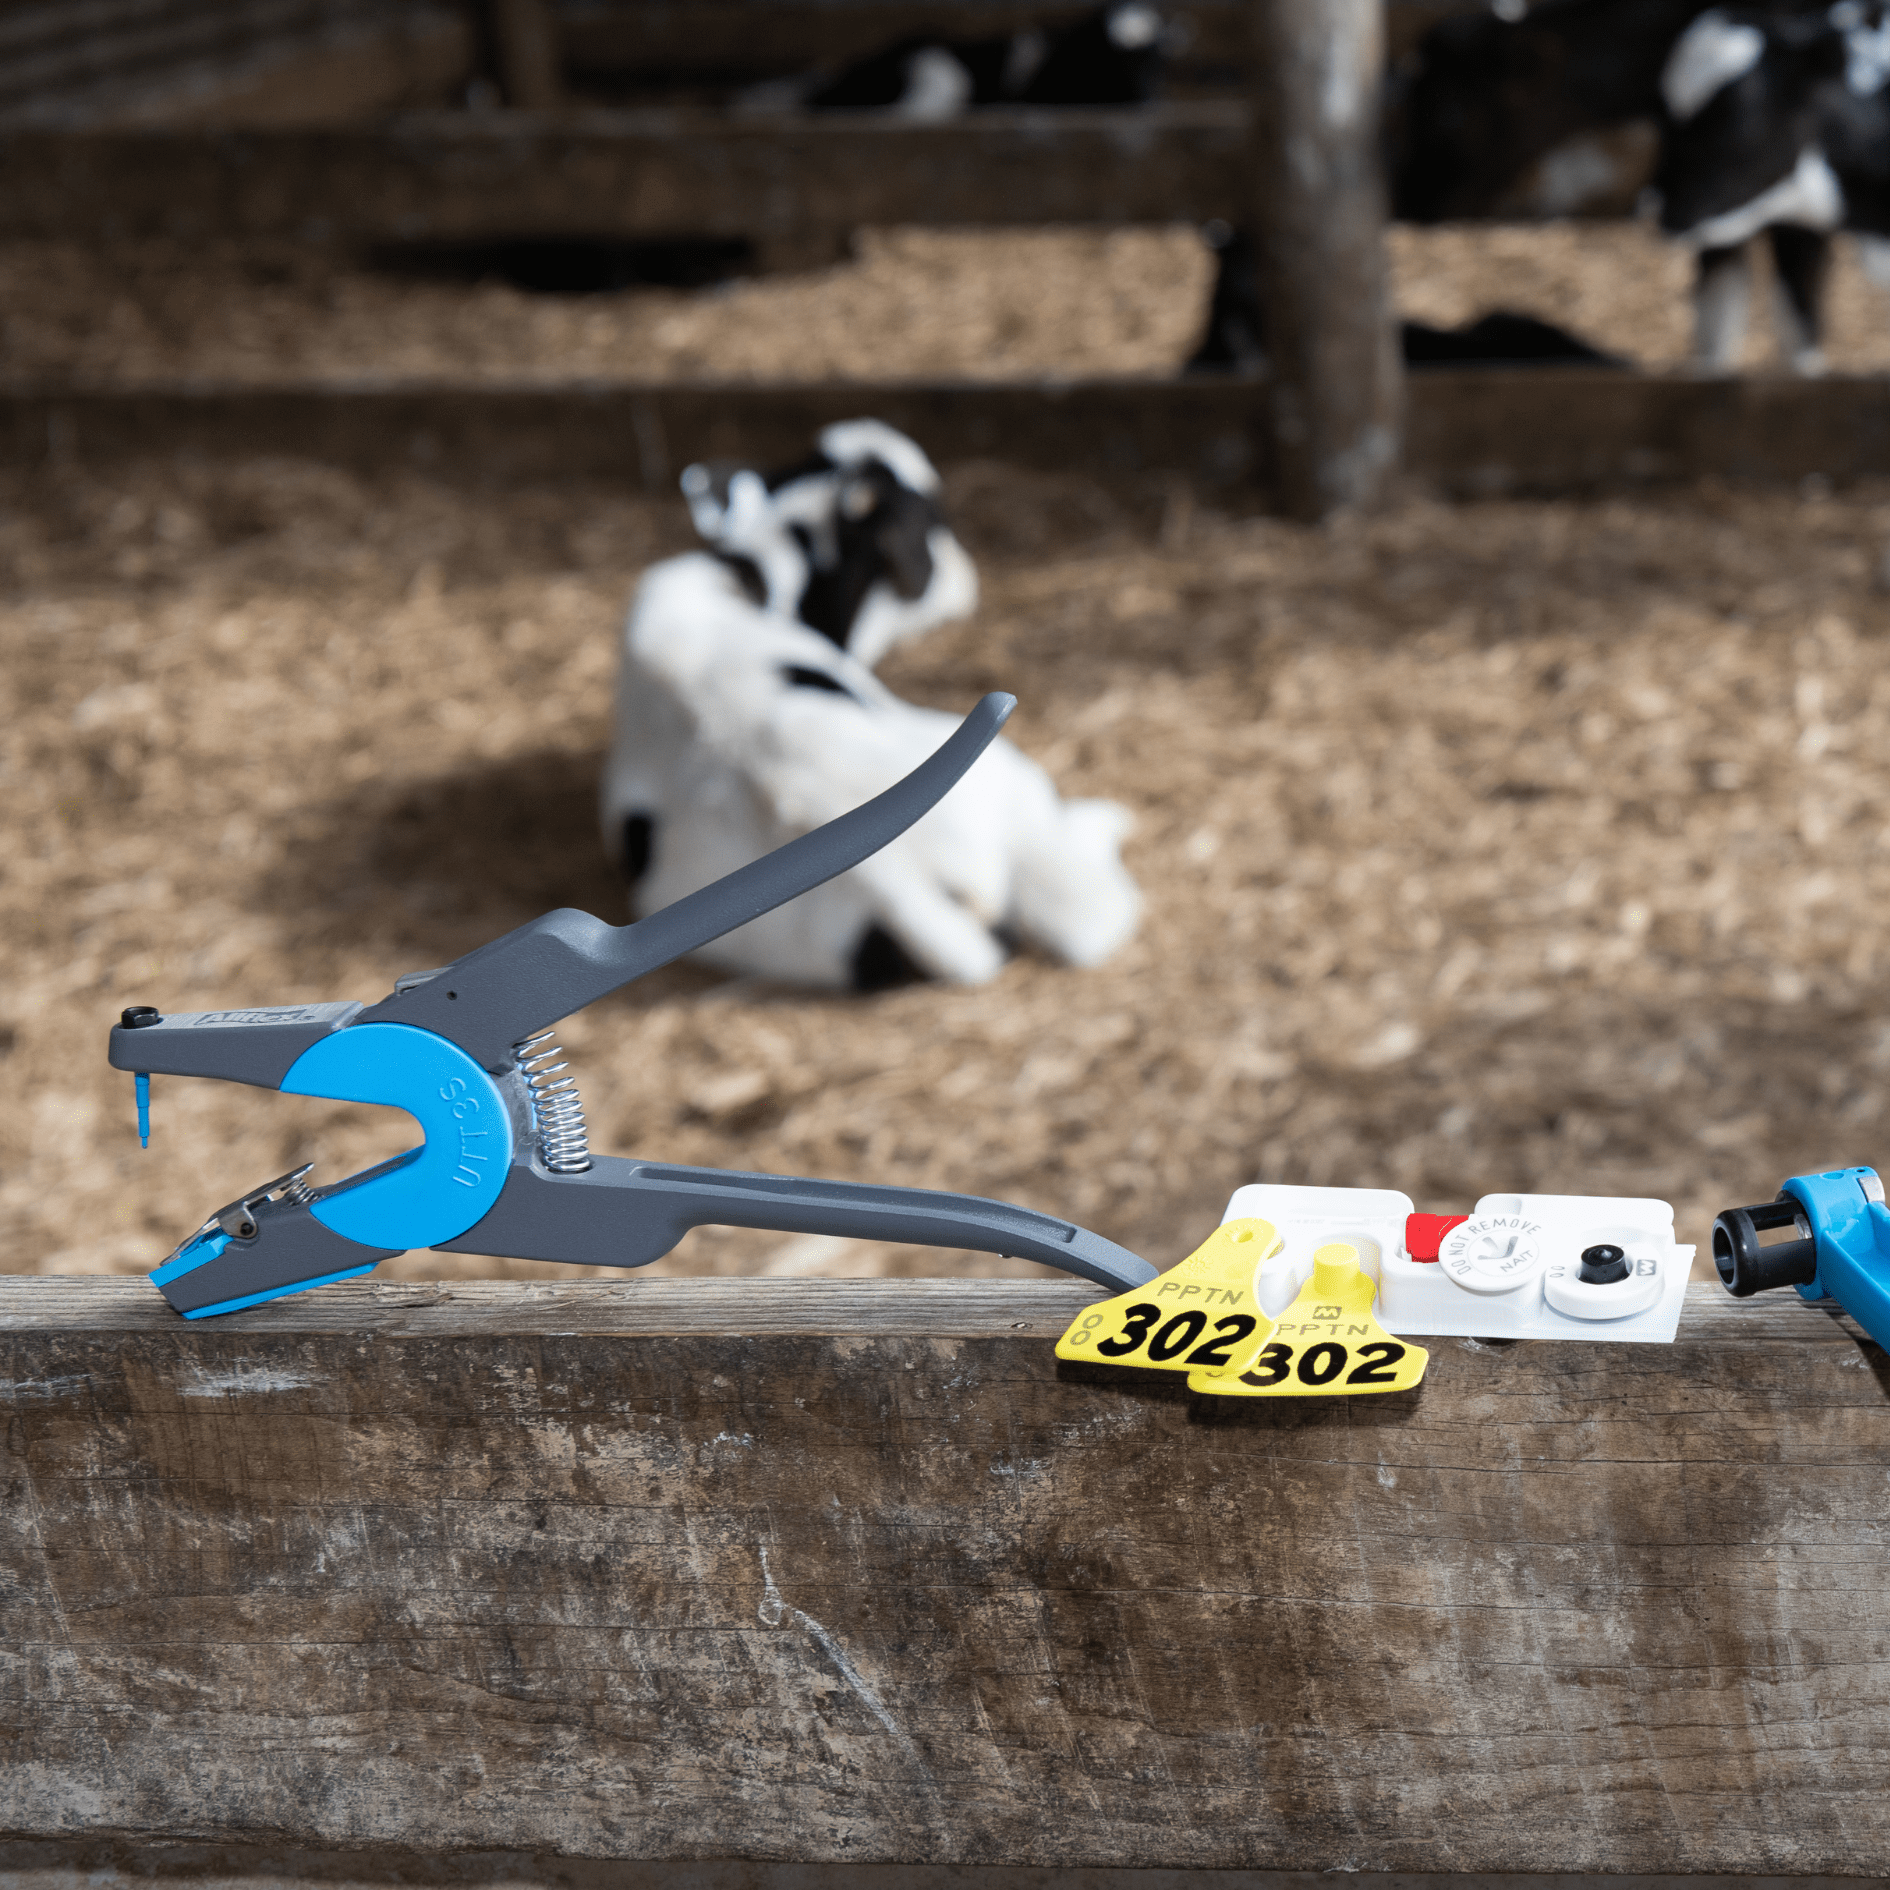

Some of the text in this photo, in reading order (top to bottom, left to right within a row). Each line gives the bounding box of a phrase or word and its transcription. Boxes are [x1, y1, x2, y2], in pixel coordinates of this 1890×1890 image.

[1447, 1217, 1542, 1276] DO NOT REMOVE
[1499, 1249, 1534, 1273] NAIT
[1157, 1282, 1245, 1306] PPTN
[1097, 1303, 1257, 1367] 302
[1275, 1323, 1370, 1336] PPTN
[1237, 1342, 1407, 1387] 302
